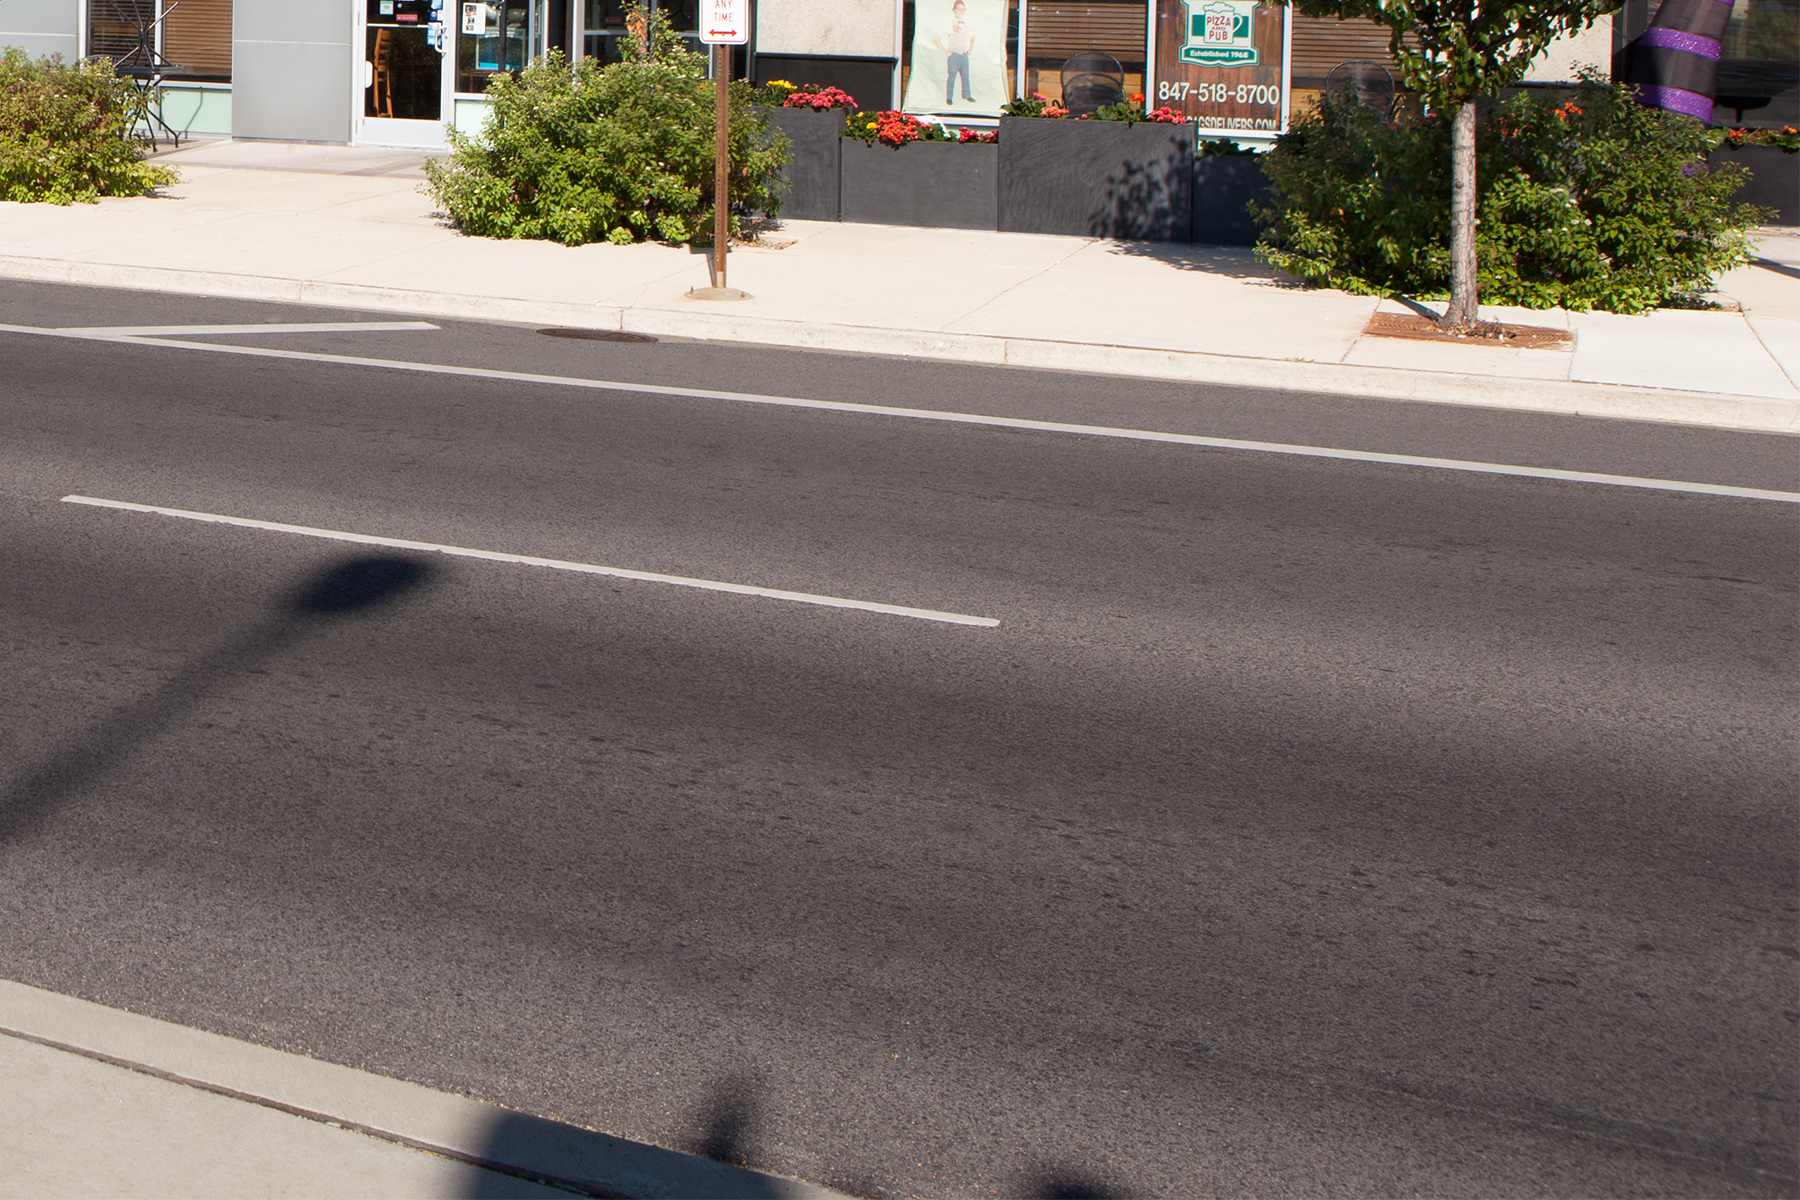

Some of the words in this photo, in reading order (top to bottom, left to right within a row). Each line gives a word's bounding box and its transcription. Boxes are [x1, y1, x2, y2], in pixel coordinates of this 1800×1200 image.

[715, 0, 733, 9] ANY
[714, 12, 733, 23] TIME
[1206, 15, 1231, 27] PIZZA
[1209, 30, 1228, 41] PUB
[1190, 49, 1229, 59] Established
[1158, 80, 1281, 106] 847-518-8700
